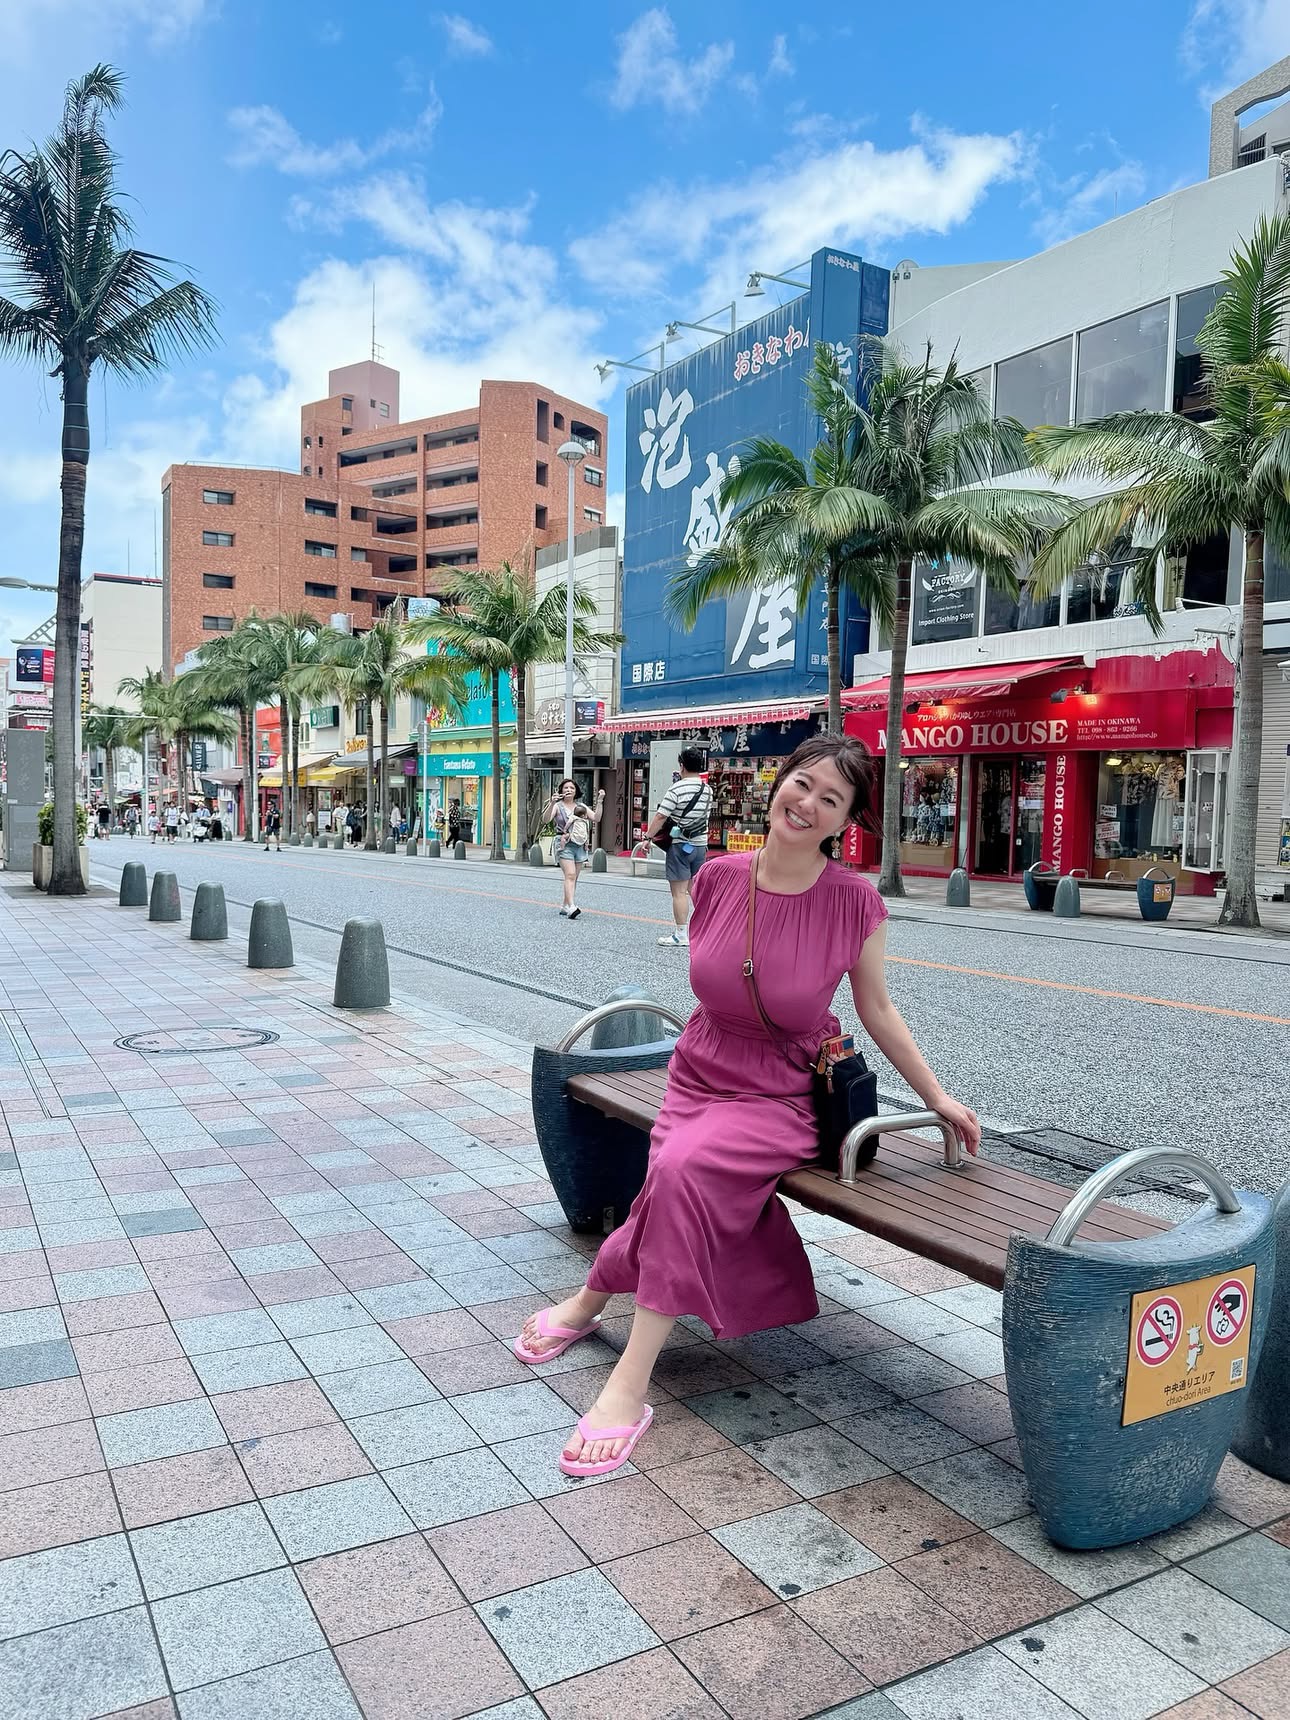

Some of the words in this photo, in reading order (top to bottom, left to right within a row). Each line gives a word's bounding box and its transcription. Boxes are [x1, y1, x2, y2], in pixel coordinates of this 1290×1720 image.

[734, 316, 810, 382] おきなわ
[931, 572, 966, 588] FACTORY
[918, 617, 936, 627] Import
[936, 614, 959, 624] Clothing
[959, 612, 974, 620] Store
[632, 662, 666, 682] 国際店
[1107, 717, 1141, 725] OKINAWA
[970, 719, 1069, 747] HOUSE
[1054, 755, 1066, 810] HOUSE
[1163, 1371, 1216, 1397] 中央通りエリア
[1197, 1386, 1212, 1398] Area
